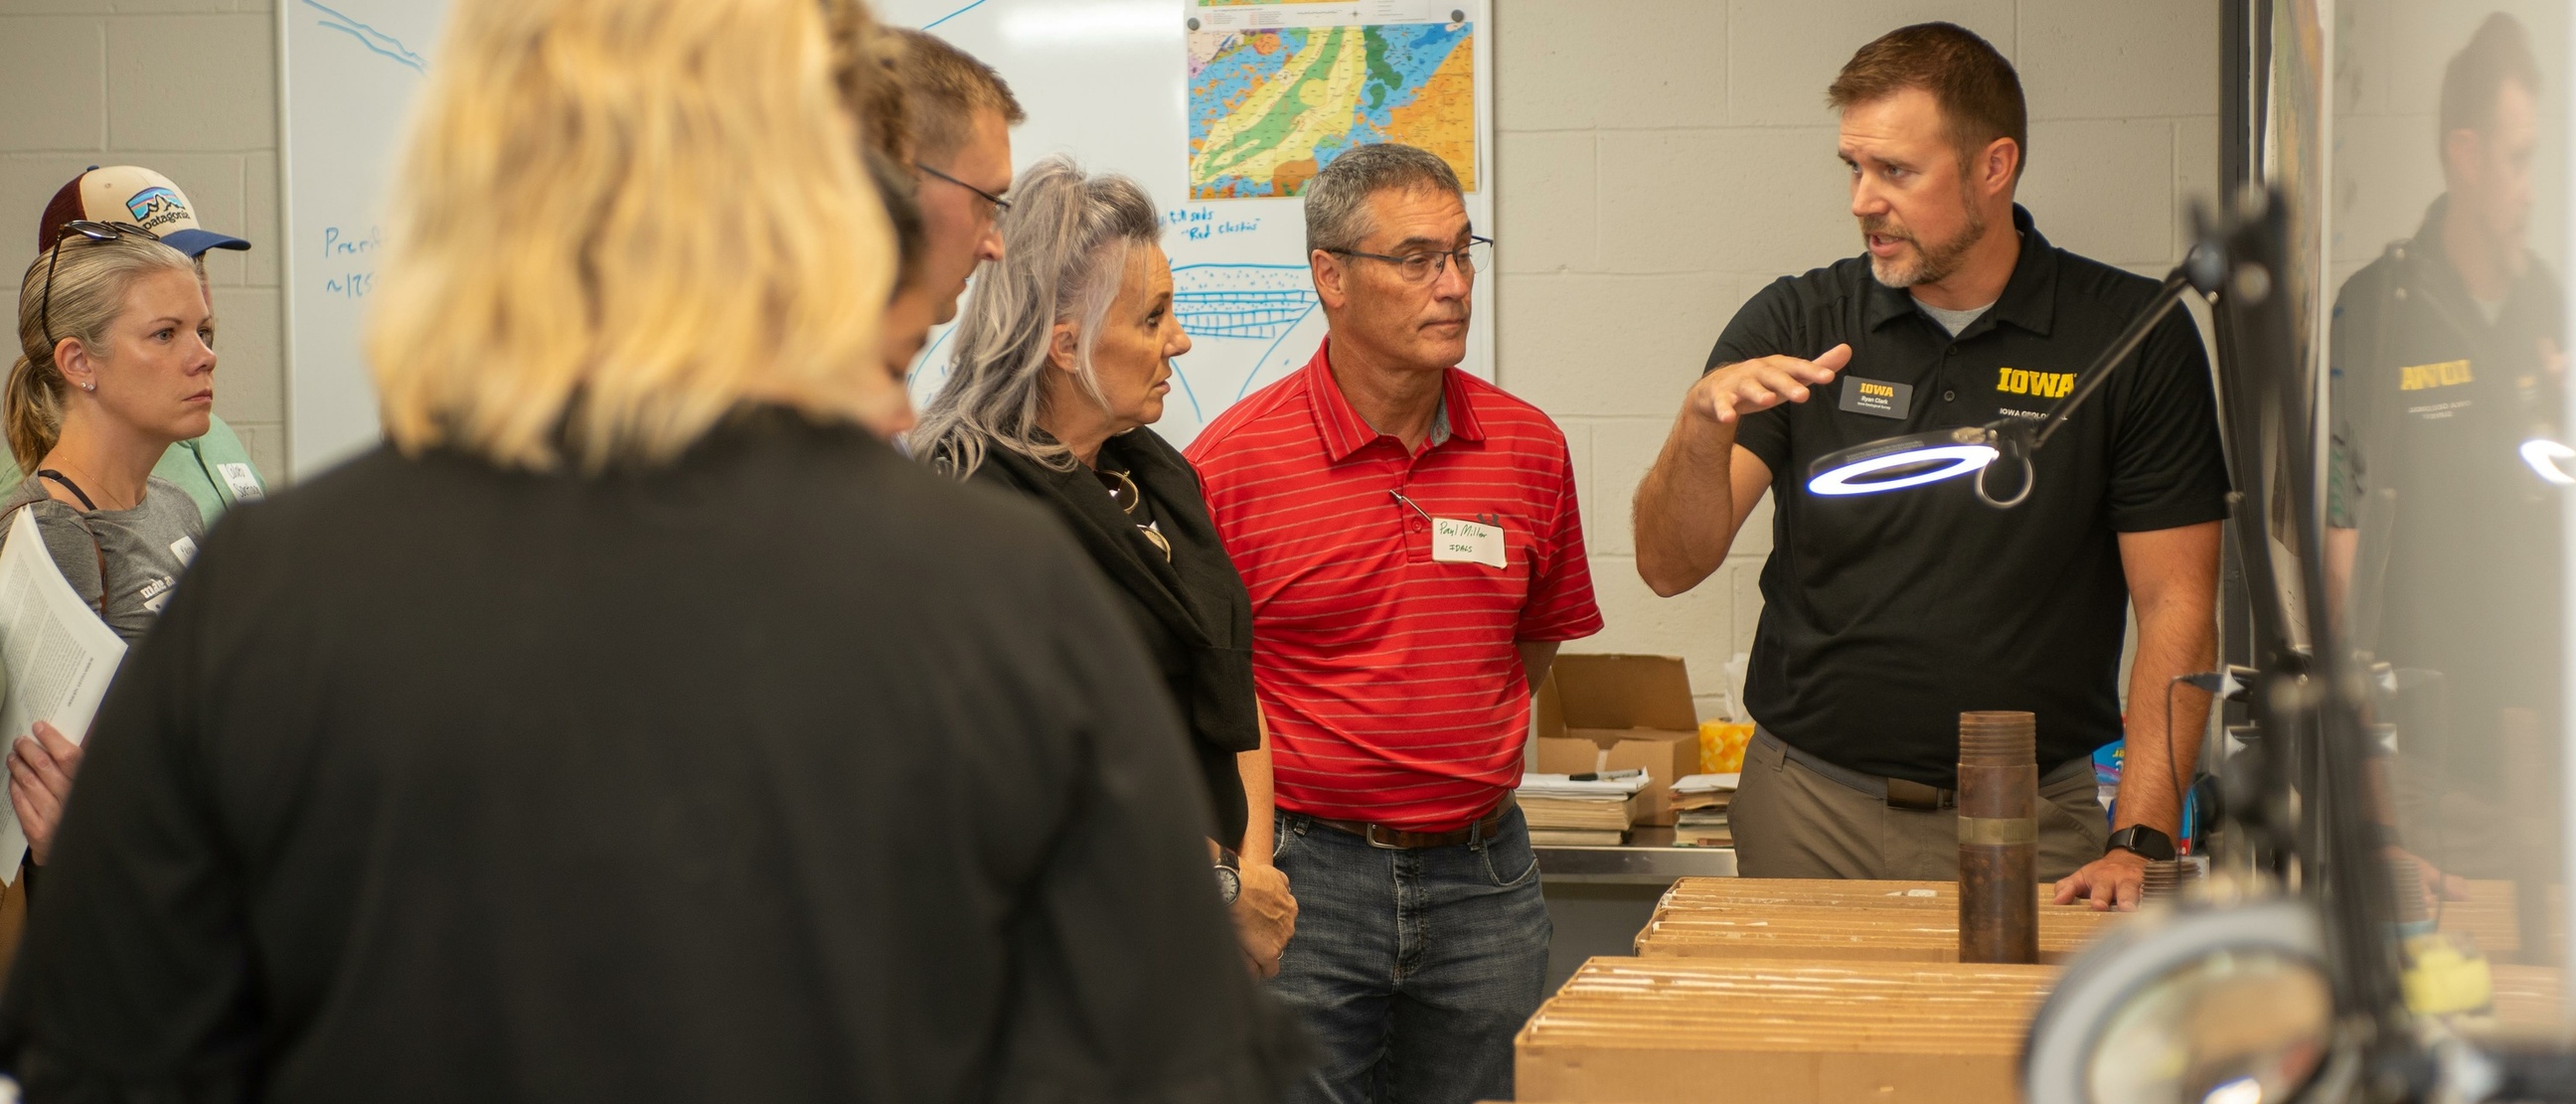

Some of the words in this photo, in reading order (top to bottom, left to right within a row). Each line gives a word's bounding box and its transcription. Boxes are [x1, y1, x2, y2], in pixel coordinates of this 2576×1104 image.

[142, 211, 191, 230] patagonia
[1859, 383, 1894, 397] IOWA
[1997, 368, 2074, 397] IOWA
[2000, 407, 2019, 416] IOWA
